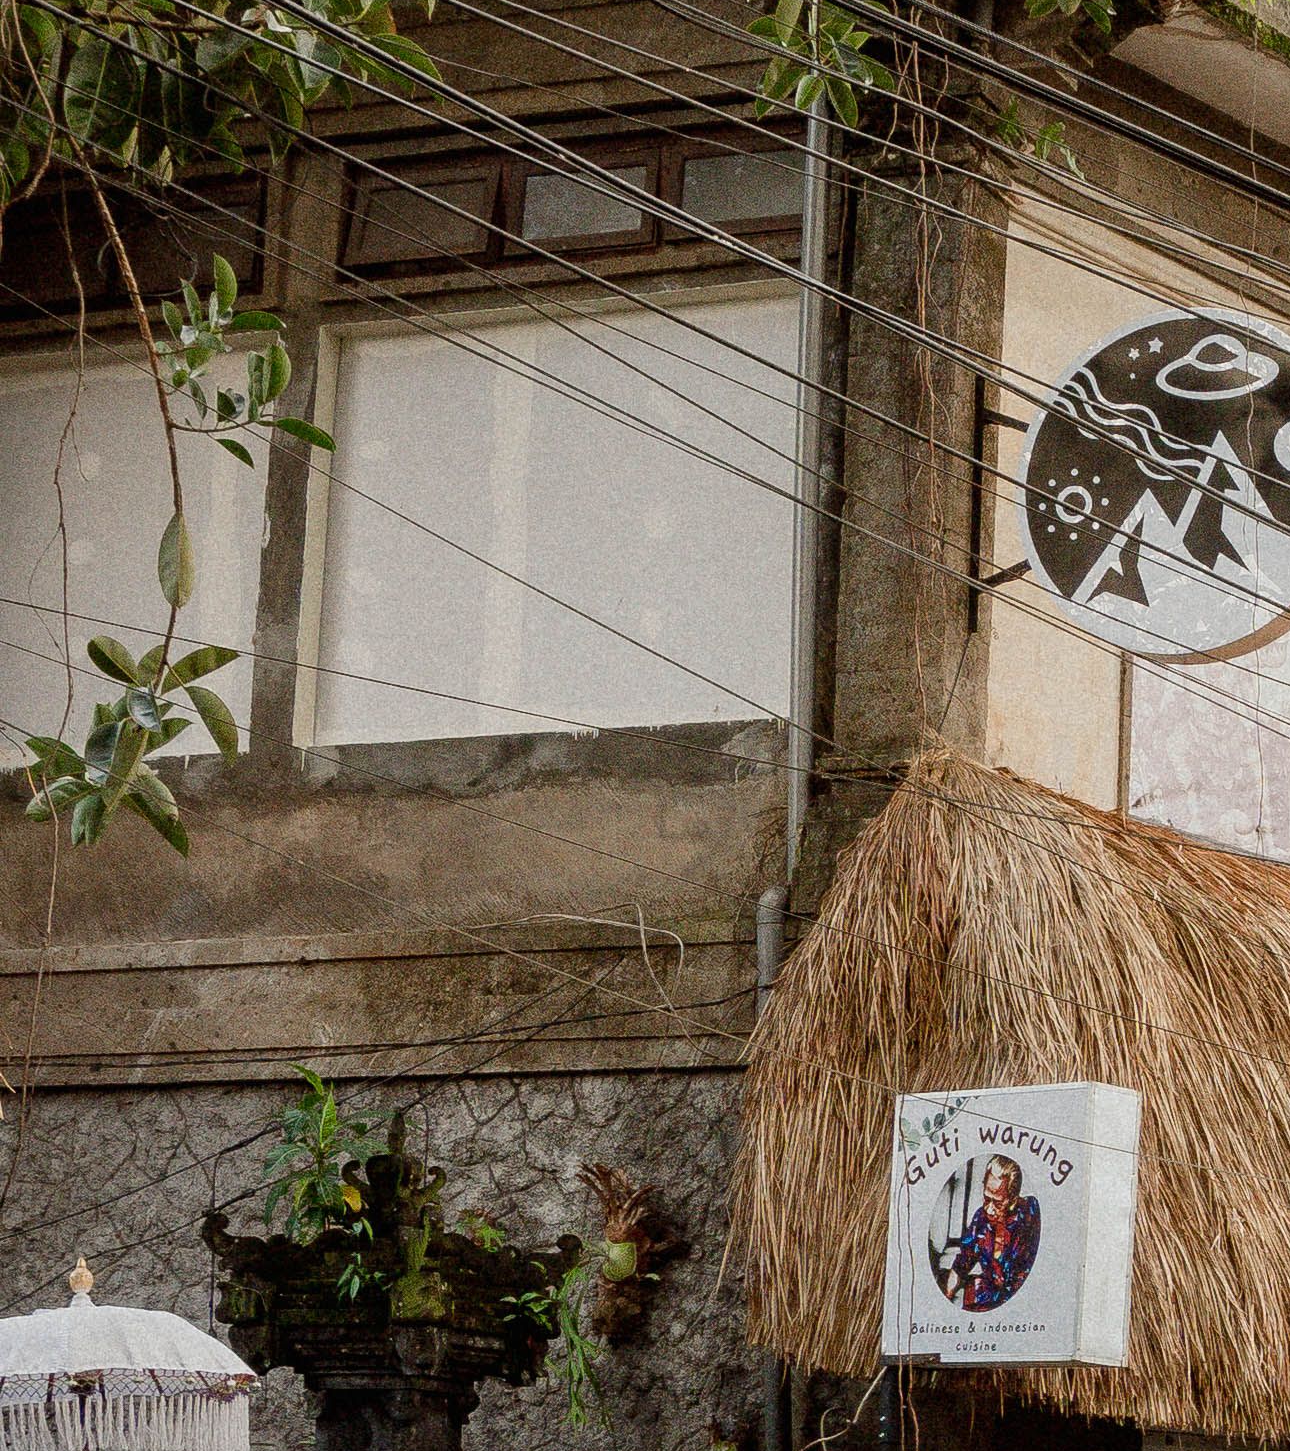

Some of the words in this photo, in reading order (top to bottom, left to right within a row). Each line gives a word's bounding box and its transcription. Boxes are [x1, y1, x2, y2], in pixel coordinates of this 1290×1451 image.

[907, 1128, 959, 1185] Guti
[979, 1124, 1074, 1186] warung
[911, 1323, 960, 1334] Balinese
[968, 1321, 976, 1333] &
[984, 1321, 1046, 1333] indonesian
[956, 1341, 997, 1351] cuisine
